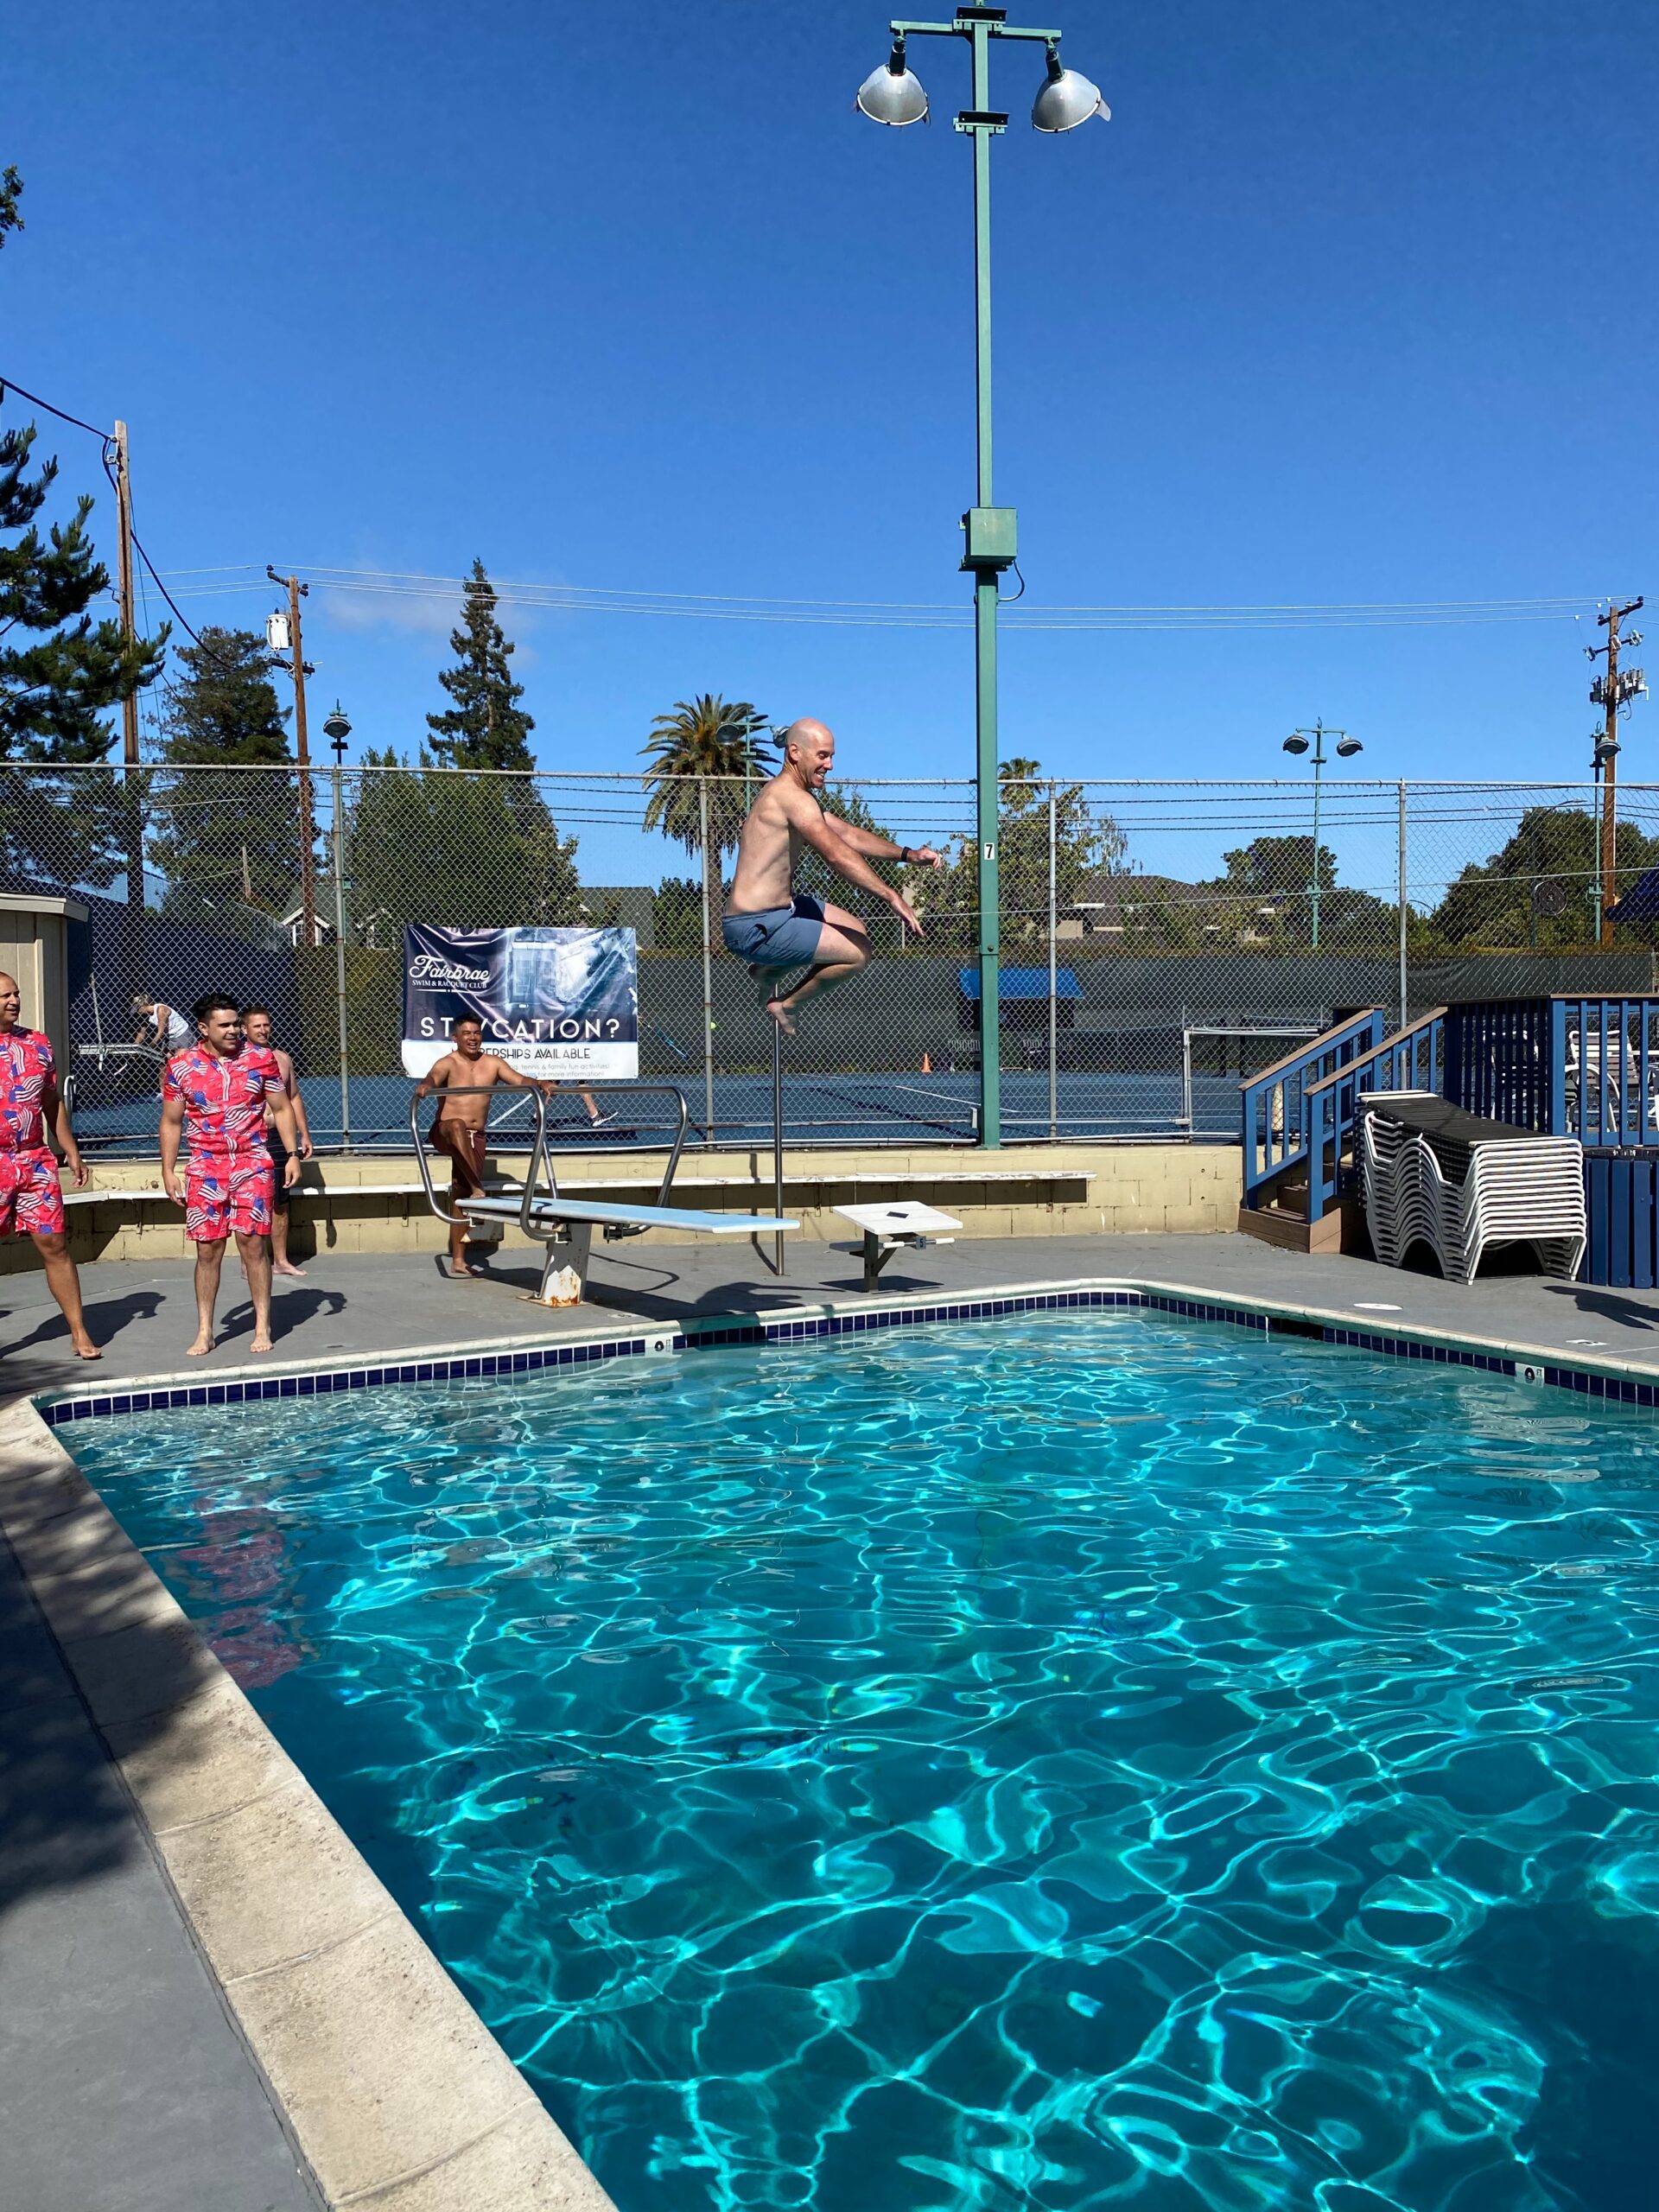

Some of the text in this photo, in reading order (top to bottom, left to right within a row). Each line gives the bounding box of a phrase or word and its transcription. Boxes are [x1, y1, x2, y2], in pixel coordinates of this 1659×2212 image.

[985, 842, 994, 860] 7
[409, 954, 491, 983] Fairbrae
[437, 980, 467, 988] RACQUET
[420, 1016, 620, 1039] STCATION?
[534, 1047, 591, 1059] AVAILABLE
